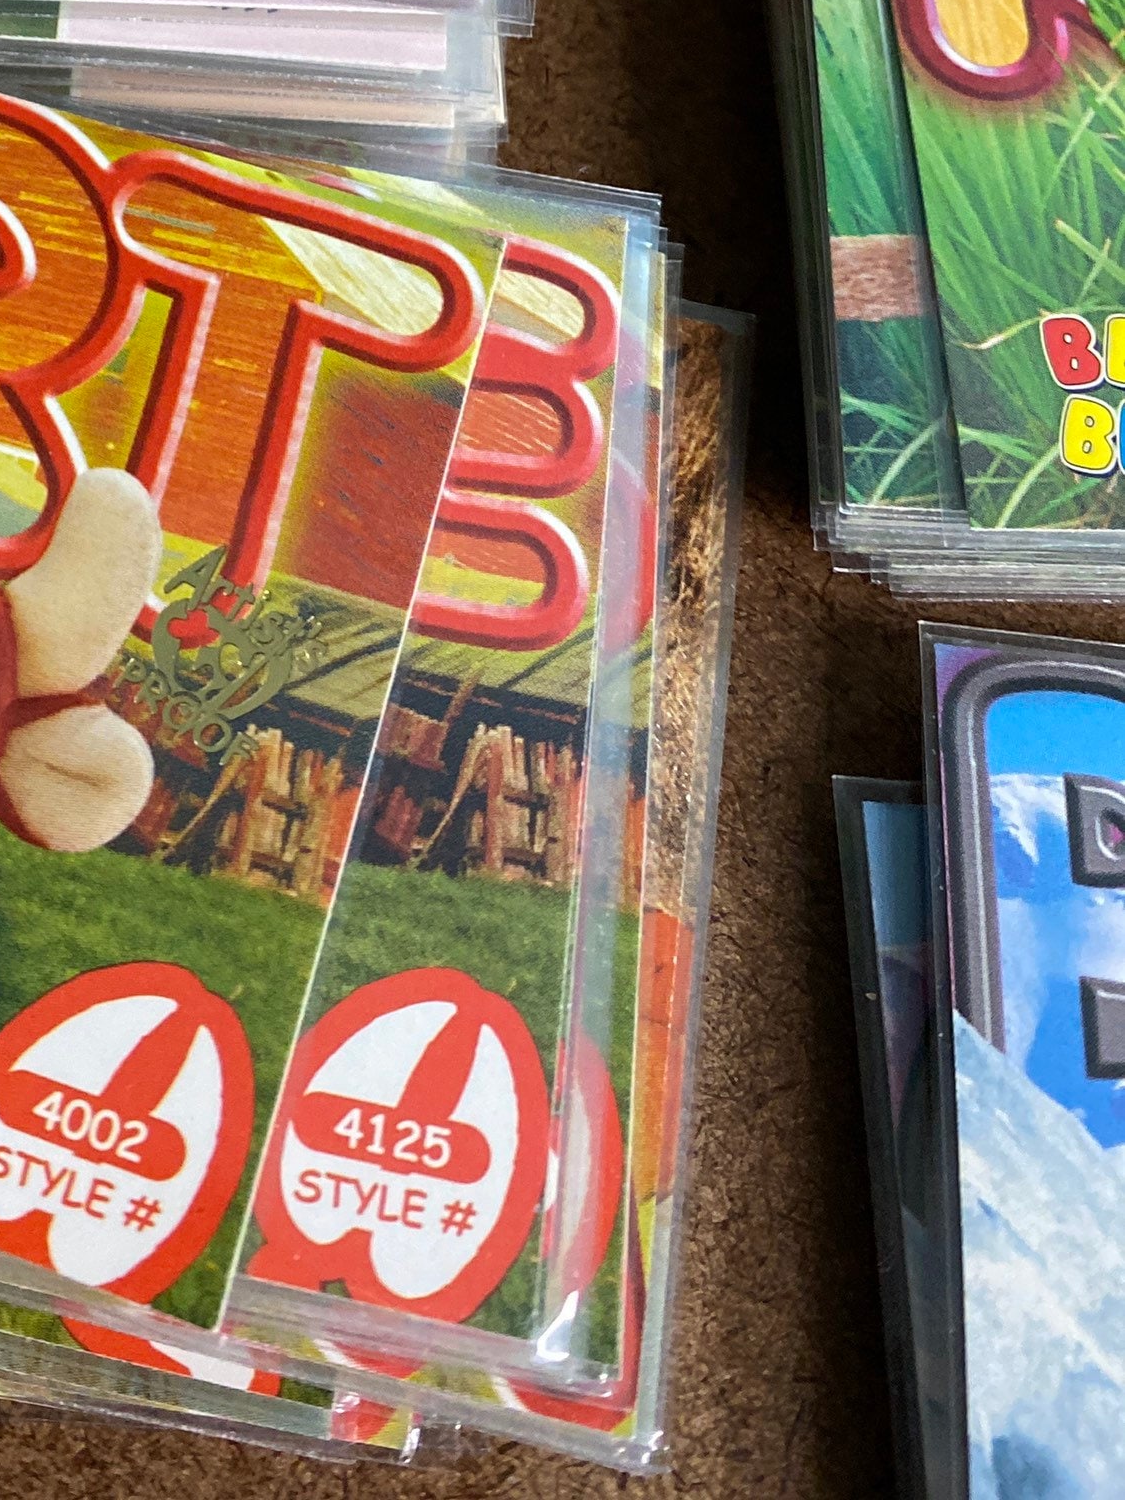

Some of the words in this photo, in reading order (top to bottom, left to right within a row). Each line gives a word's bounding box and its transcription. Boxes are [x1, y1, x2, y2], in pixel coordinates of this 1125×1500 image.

[113, 656, 260, 767] PROOF
[32, 1090, 150, 1165] 4002
[334, 1106, 452, 1171] 4125
[124, 1196, 165, 1234] #
[293, 1171, 427, 1232] STYLE
[441, 1198, 479, 1238] #
